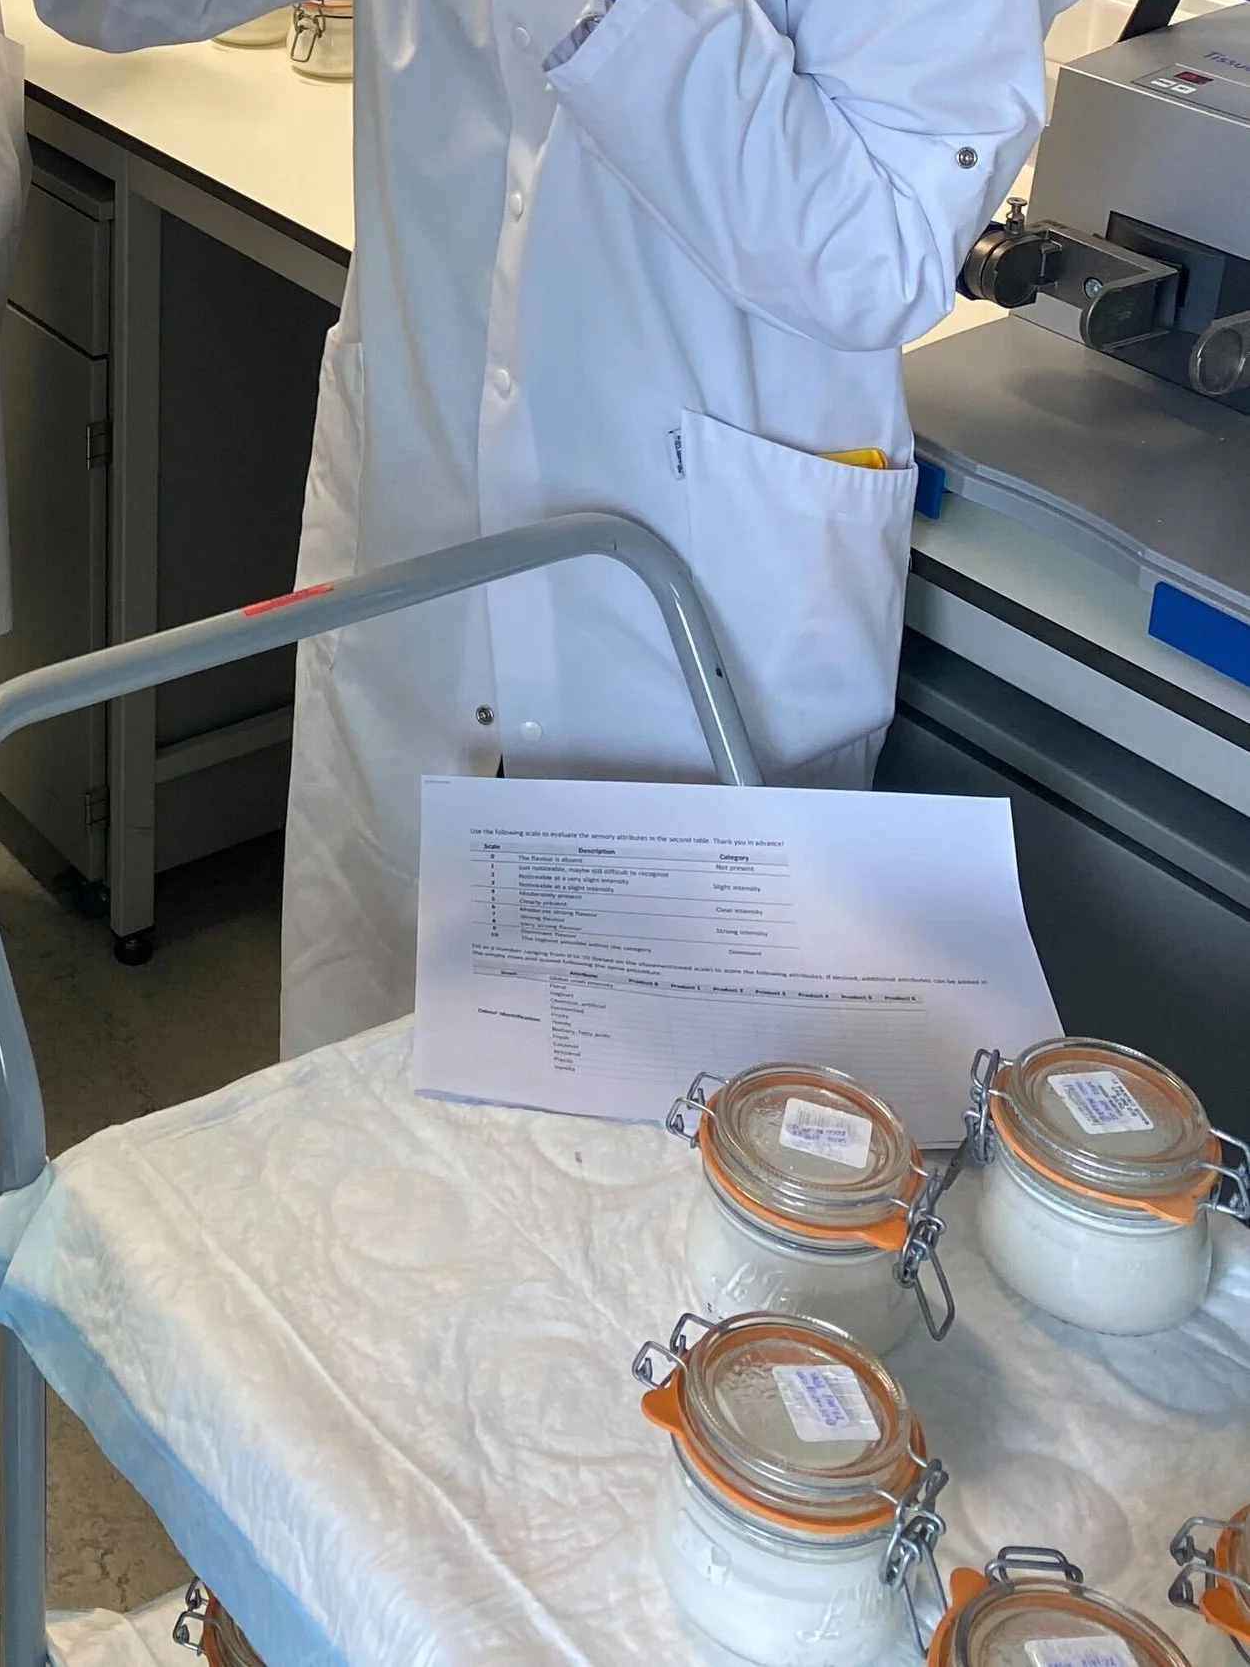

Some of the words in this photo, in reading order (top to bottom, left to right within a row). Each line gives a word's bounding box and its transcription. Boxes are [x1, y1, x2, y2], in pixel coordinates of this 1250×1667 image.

[495, 829, 523, 838] following
[578, 847, 616, 856] Description
[720, 854, 749, 862] Category
[569, 867, 590, 875] maybe
[733, 885, 760, 893] intensity
[519, 891, 556, 899] Moderately
[554, 909, 574, 917] strong
[623, 944, 651, 953] category
